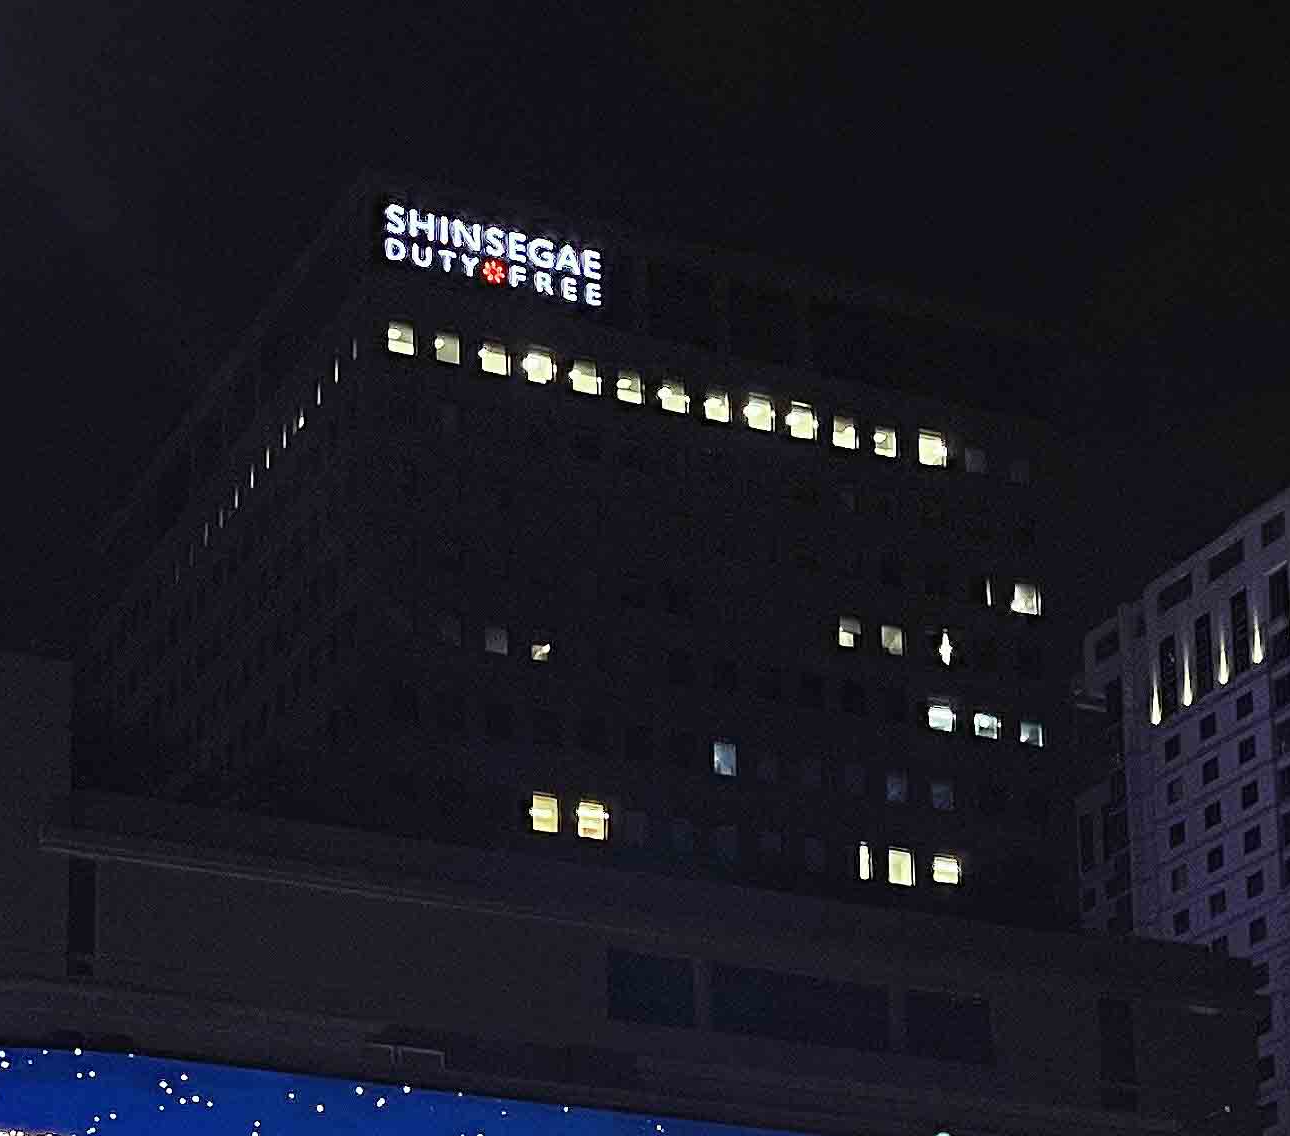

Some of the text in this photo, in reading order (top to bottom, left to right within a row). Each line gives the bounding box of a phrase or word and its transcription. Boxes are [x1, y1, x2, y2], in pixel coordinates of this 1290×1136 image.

[385, 203, 602, 280] SHINSEGAE
[385, 238, 602, 306] DUTY FREE
